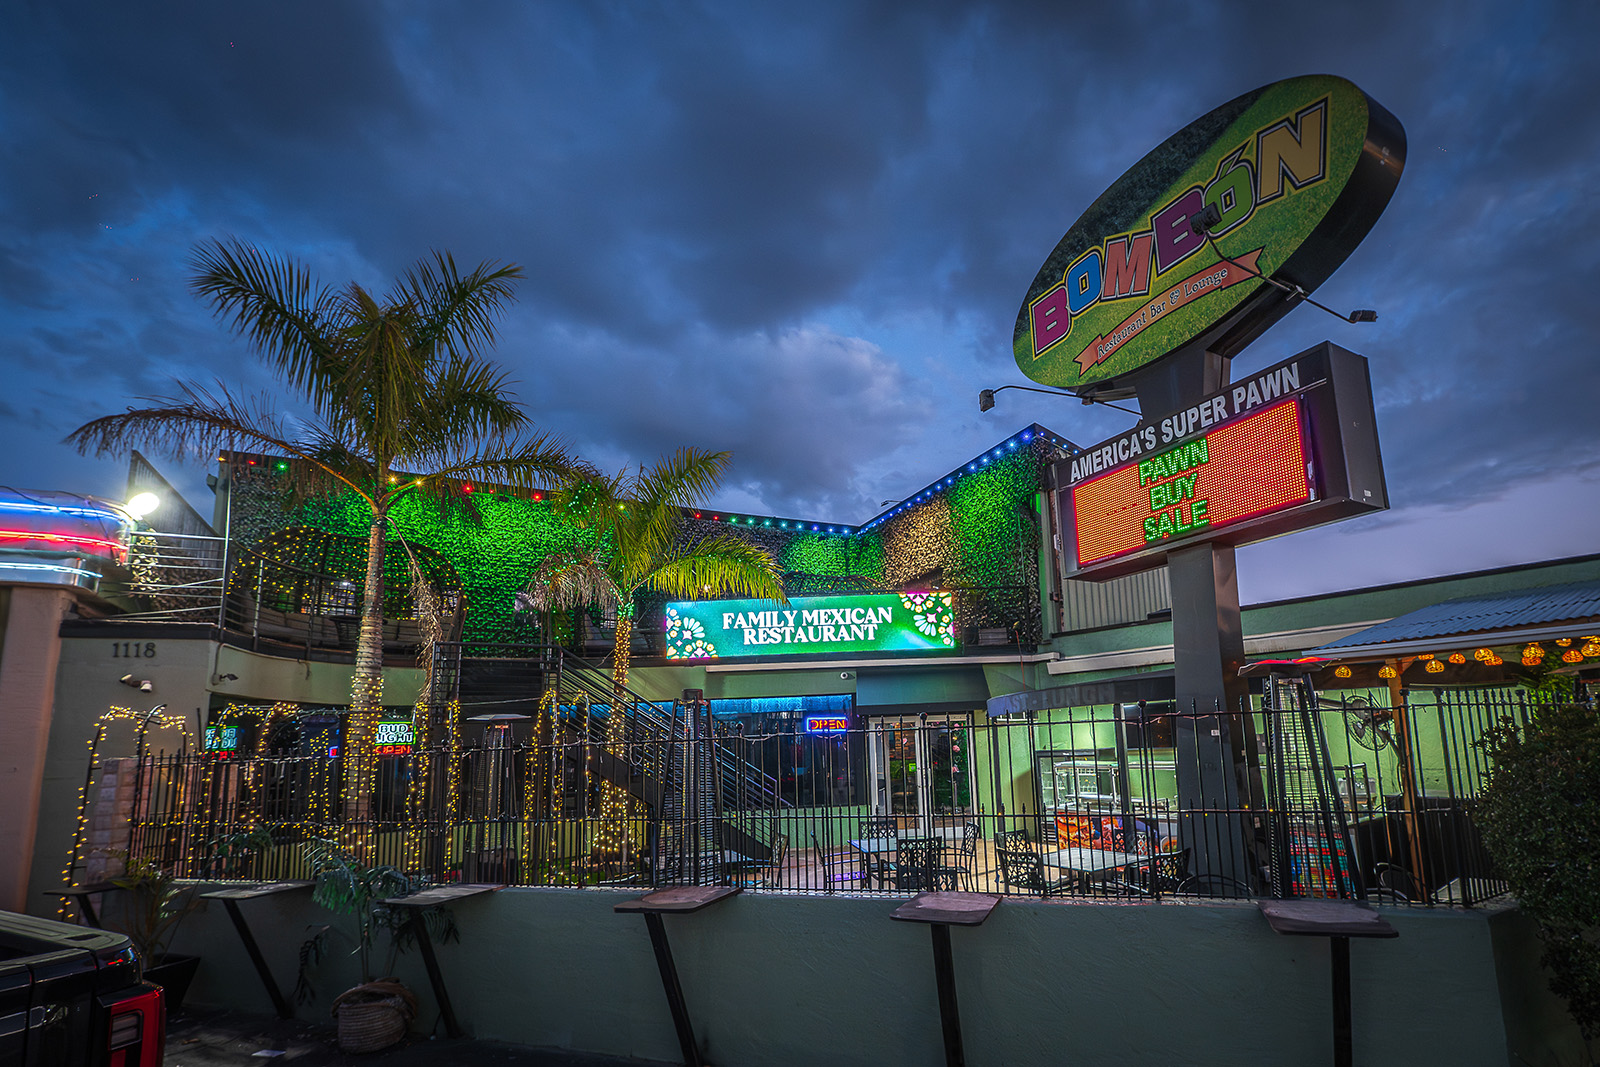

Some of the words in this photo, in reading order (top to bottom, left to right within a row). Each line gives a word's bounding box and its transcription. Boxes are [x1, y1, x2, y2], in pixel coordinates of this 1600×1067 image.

[1030, 96, 1329, 356] BOMBÓN
[1097, 311, 1147, 359] Restaurant
[1149, 301, 1166, 319] Bar
[1169, 289, 1180, 305] &
[1183, 268, 1228, 298] Lounge
[1070, 425, 1157, 483] AMERICA'S
[1161, 394, 1228, 443] SUPER
[1232, 362, 1300, 414] PAWN
[1139, 438, 1209, 487] PAWN
[1150, 472, 1198, 511] BUY
[1144, 499, 1210, 541] SALE
[722, 610, 798, 630] FAMILY
[801, 607, 893, 626] MEXICAN
[112, 642, 156, 658] 1118
[743, 623, 878, 646] RESTAURANT
[375, 732, 413, 743] LIGHT
[378, 723, 409, 733] BUD
[810, 719, 846, 730] OPEN
